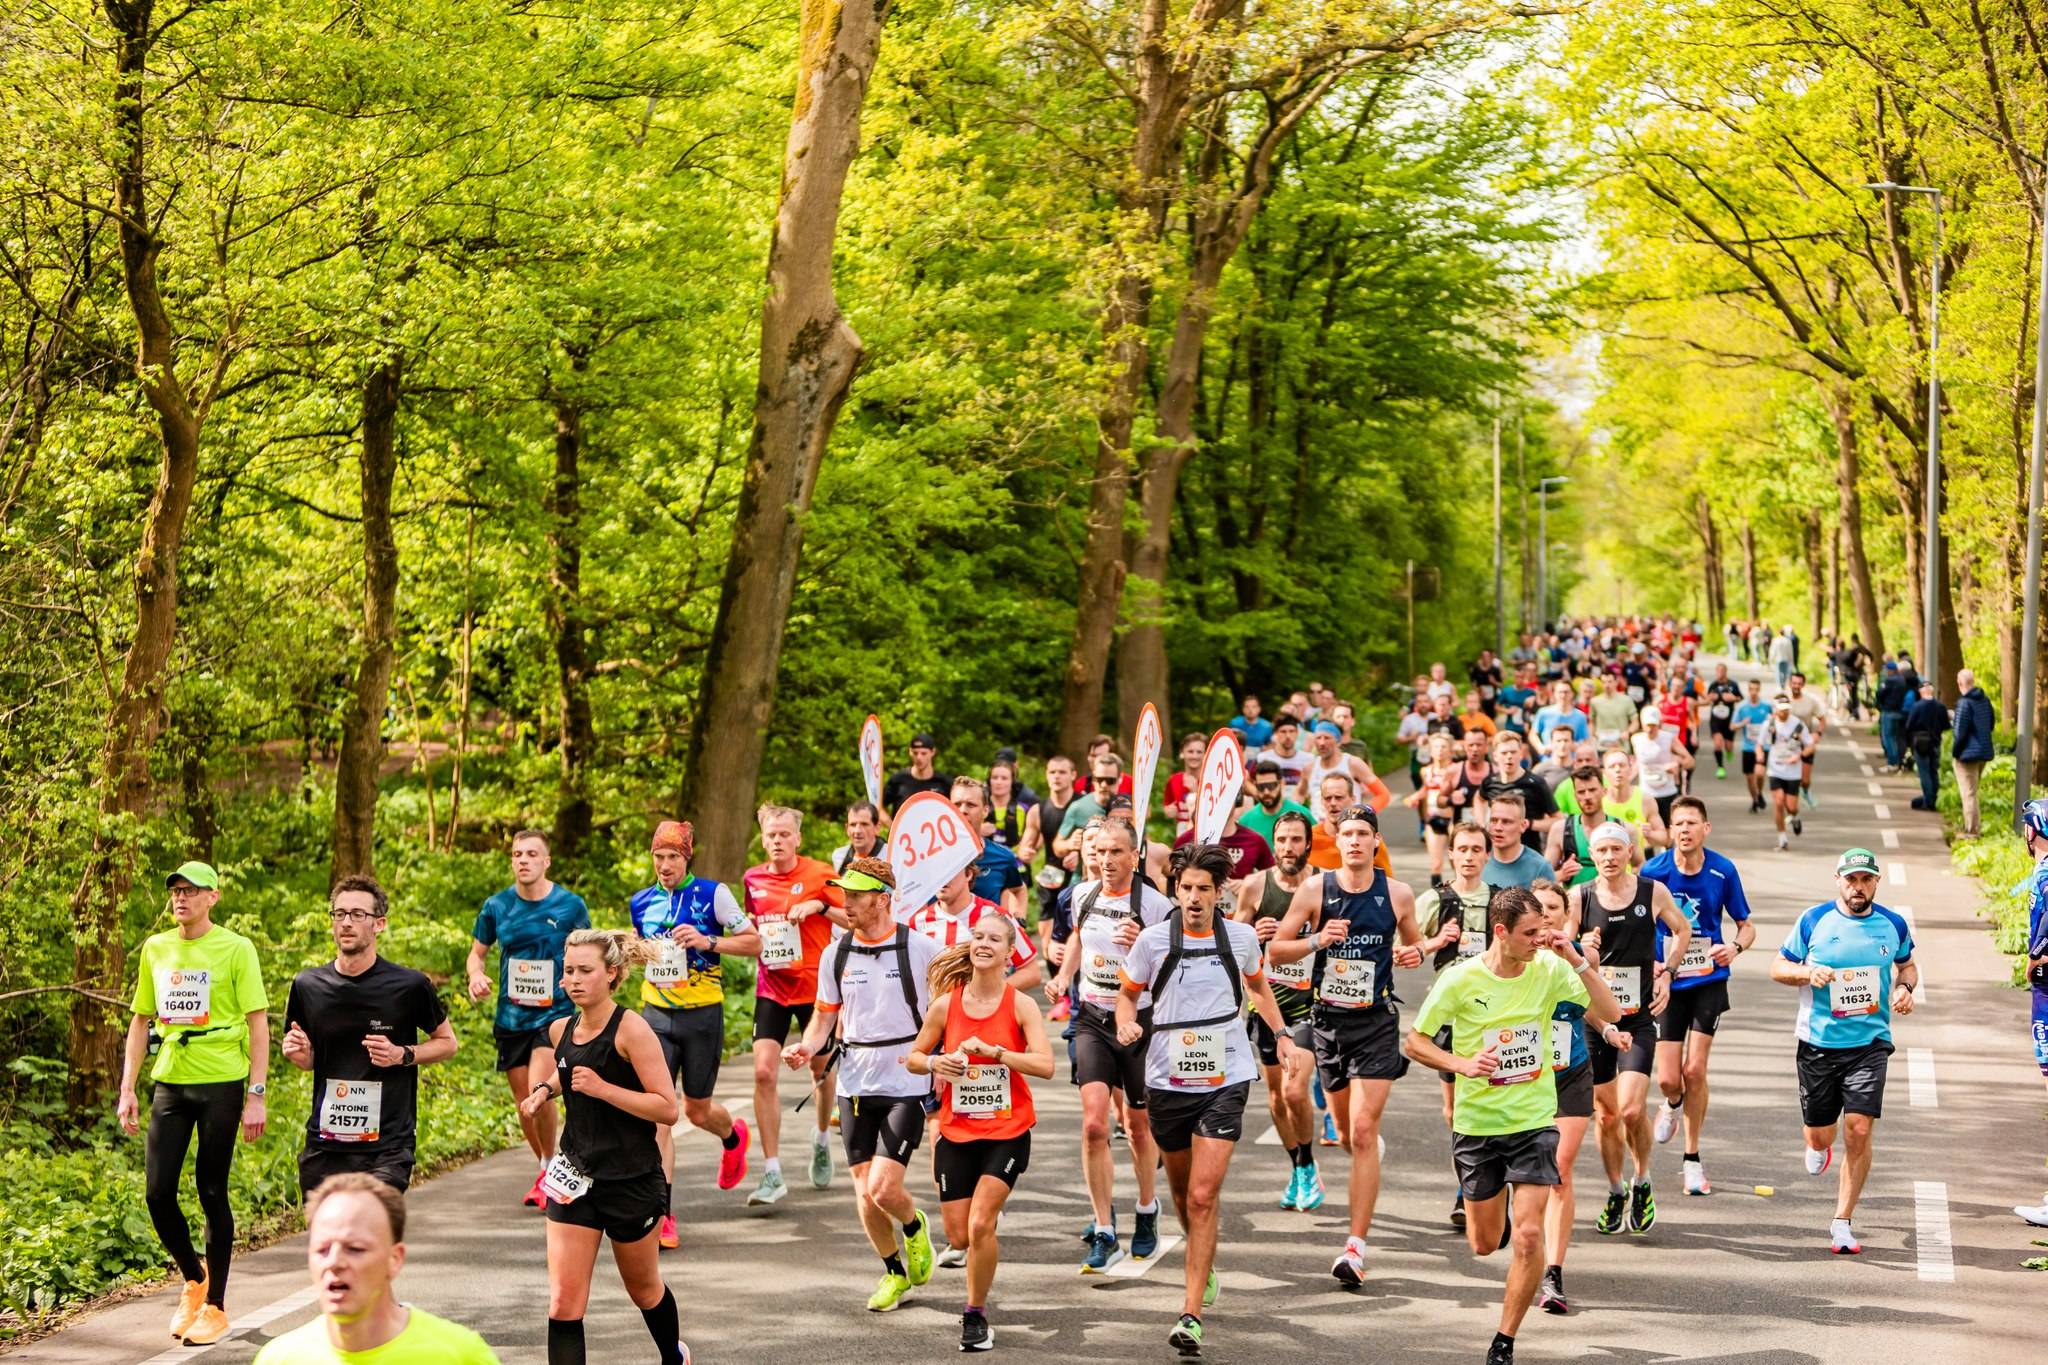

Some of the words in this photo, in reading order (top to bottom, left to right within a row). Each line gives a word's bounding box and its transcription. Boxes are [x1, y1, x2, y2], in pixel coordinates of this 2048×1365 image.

[1203, 747, 1234, 817] 3.20
[899, 813, 958, 868] 3.20
[764, 947, 795, 958] 21924
[530, 964, 542, 972] NN
[1107, 959, 1119, 967] NN
[1271, 965, 1305, 978] 19035
[1337, 978, 1358, 986] THIJS
[168, 990, 199, 998] JEROEN
[515, 984, 546, 995] 12766
[1327, 984, 1367, 998] 20424
[1844, 985, 1868, 993] VAIOS
[1840, 993, 1872, 1005] 11632
[164, 1000, 202, 1011] 16407
[1515, 1028, 1529, 1038] NN
[1184, 1051, 1208, 1059] LEON
[1501, 1045, 1529, 1057] KEVIN
[1177, 1061, 1216, 1072] 12195
[1499, 1054, 1537, 1071] 14153
[981, 1068, 996, 1077] NN
[350, 1087, 366, 1095] NN
[959, 1083, 1002, 1093] MICHELLE
[959, 1094, 1003, 1106] 20594
[329, 1103, 369, 1113] ANTOINE
[328, 1114, 369, 1128] 21577
